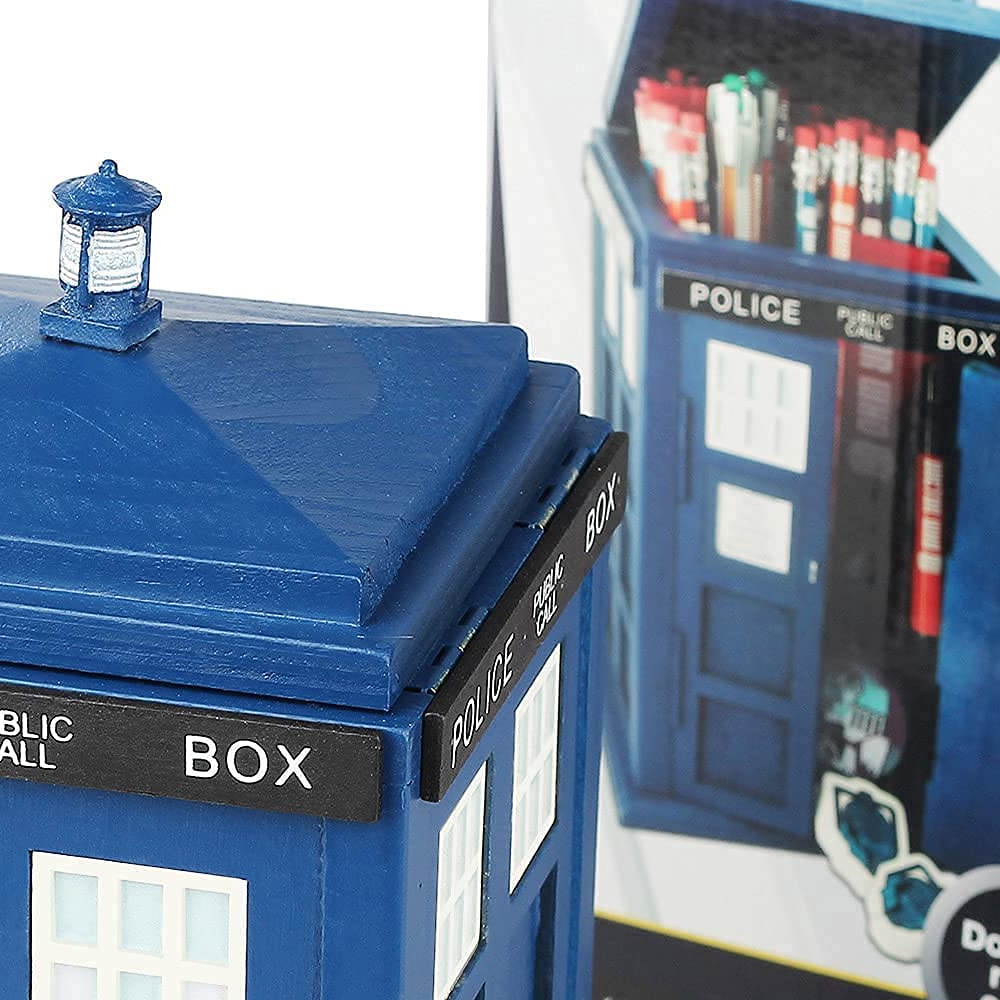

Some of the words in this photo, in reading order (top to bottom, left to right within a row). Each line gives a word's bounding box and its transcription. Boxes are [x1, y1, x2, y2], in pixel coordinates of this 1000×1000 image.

[690, 282, 801, 326] POLICE
[837, 305, 894, 331] PUBLIC
[937, 324, 997, 358] BOX
[844, 321, 885, 343] CALL
[450, 632, 515, 769] POLICE
[532, 552, 565, 618] PUBLIC
[584, 472, 618, 553] BOX
[535, 593, 558, 637] CALL
[183, 733, 314, 790] BOX
